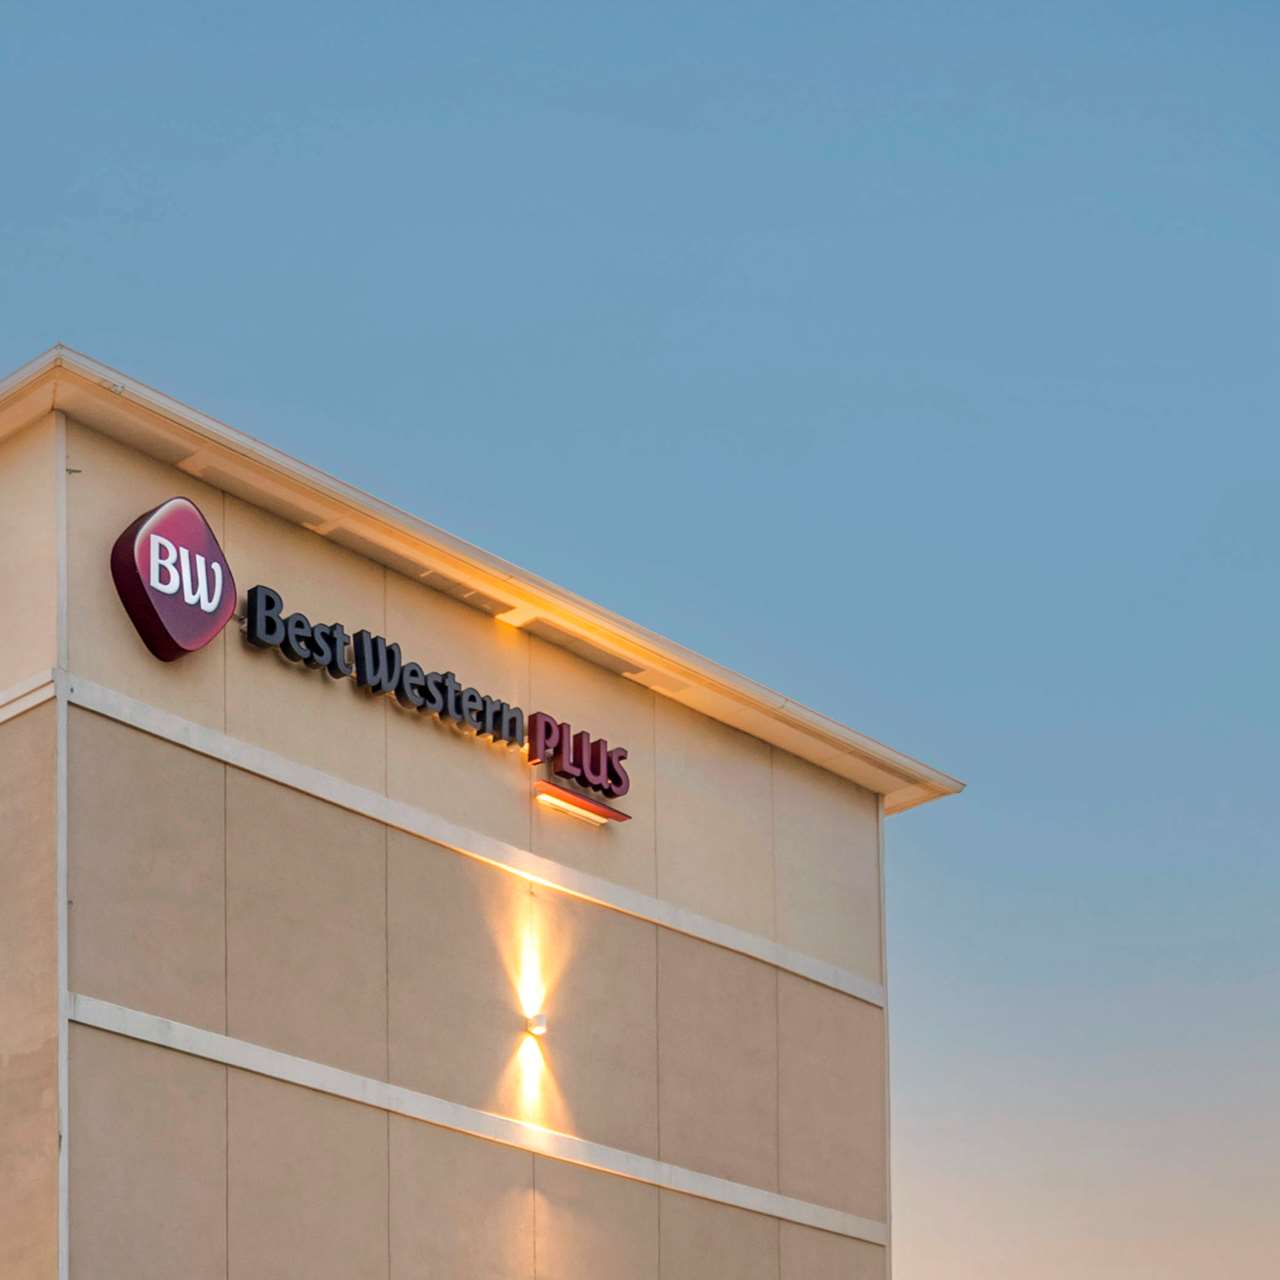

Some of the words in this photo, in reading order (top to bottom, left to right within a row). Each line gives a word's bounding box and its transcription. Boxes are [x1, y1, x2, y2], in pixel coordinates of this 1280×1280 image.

[148, 533, 223, 614] BW
[246, 584, 353, 679] Best
[352, 629, 525, 748] Western
[527, 711, 631, 799] PLUS
